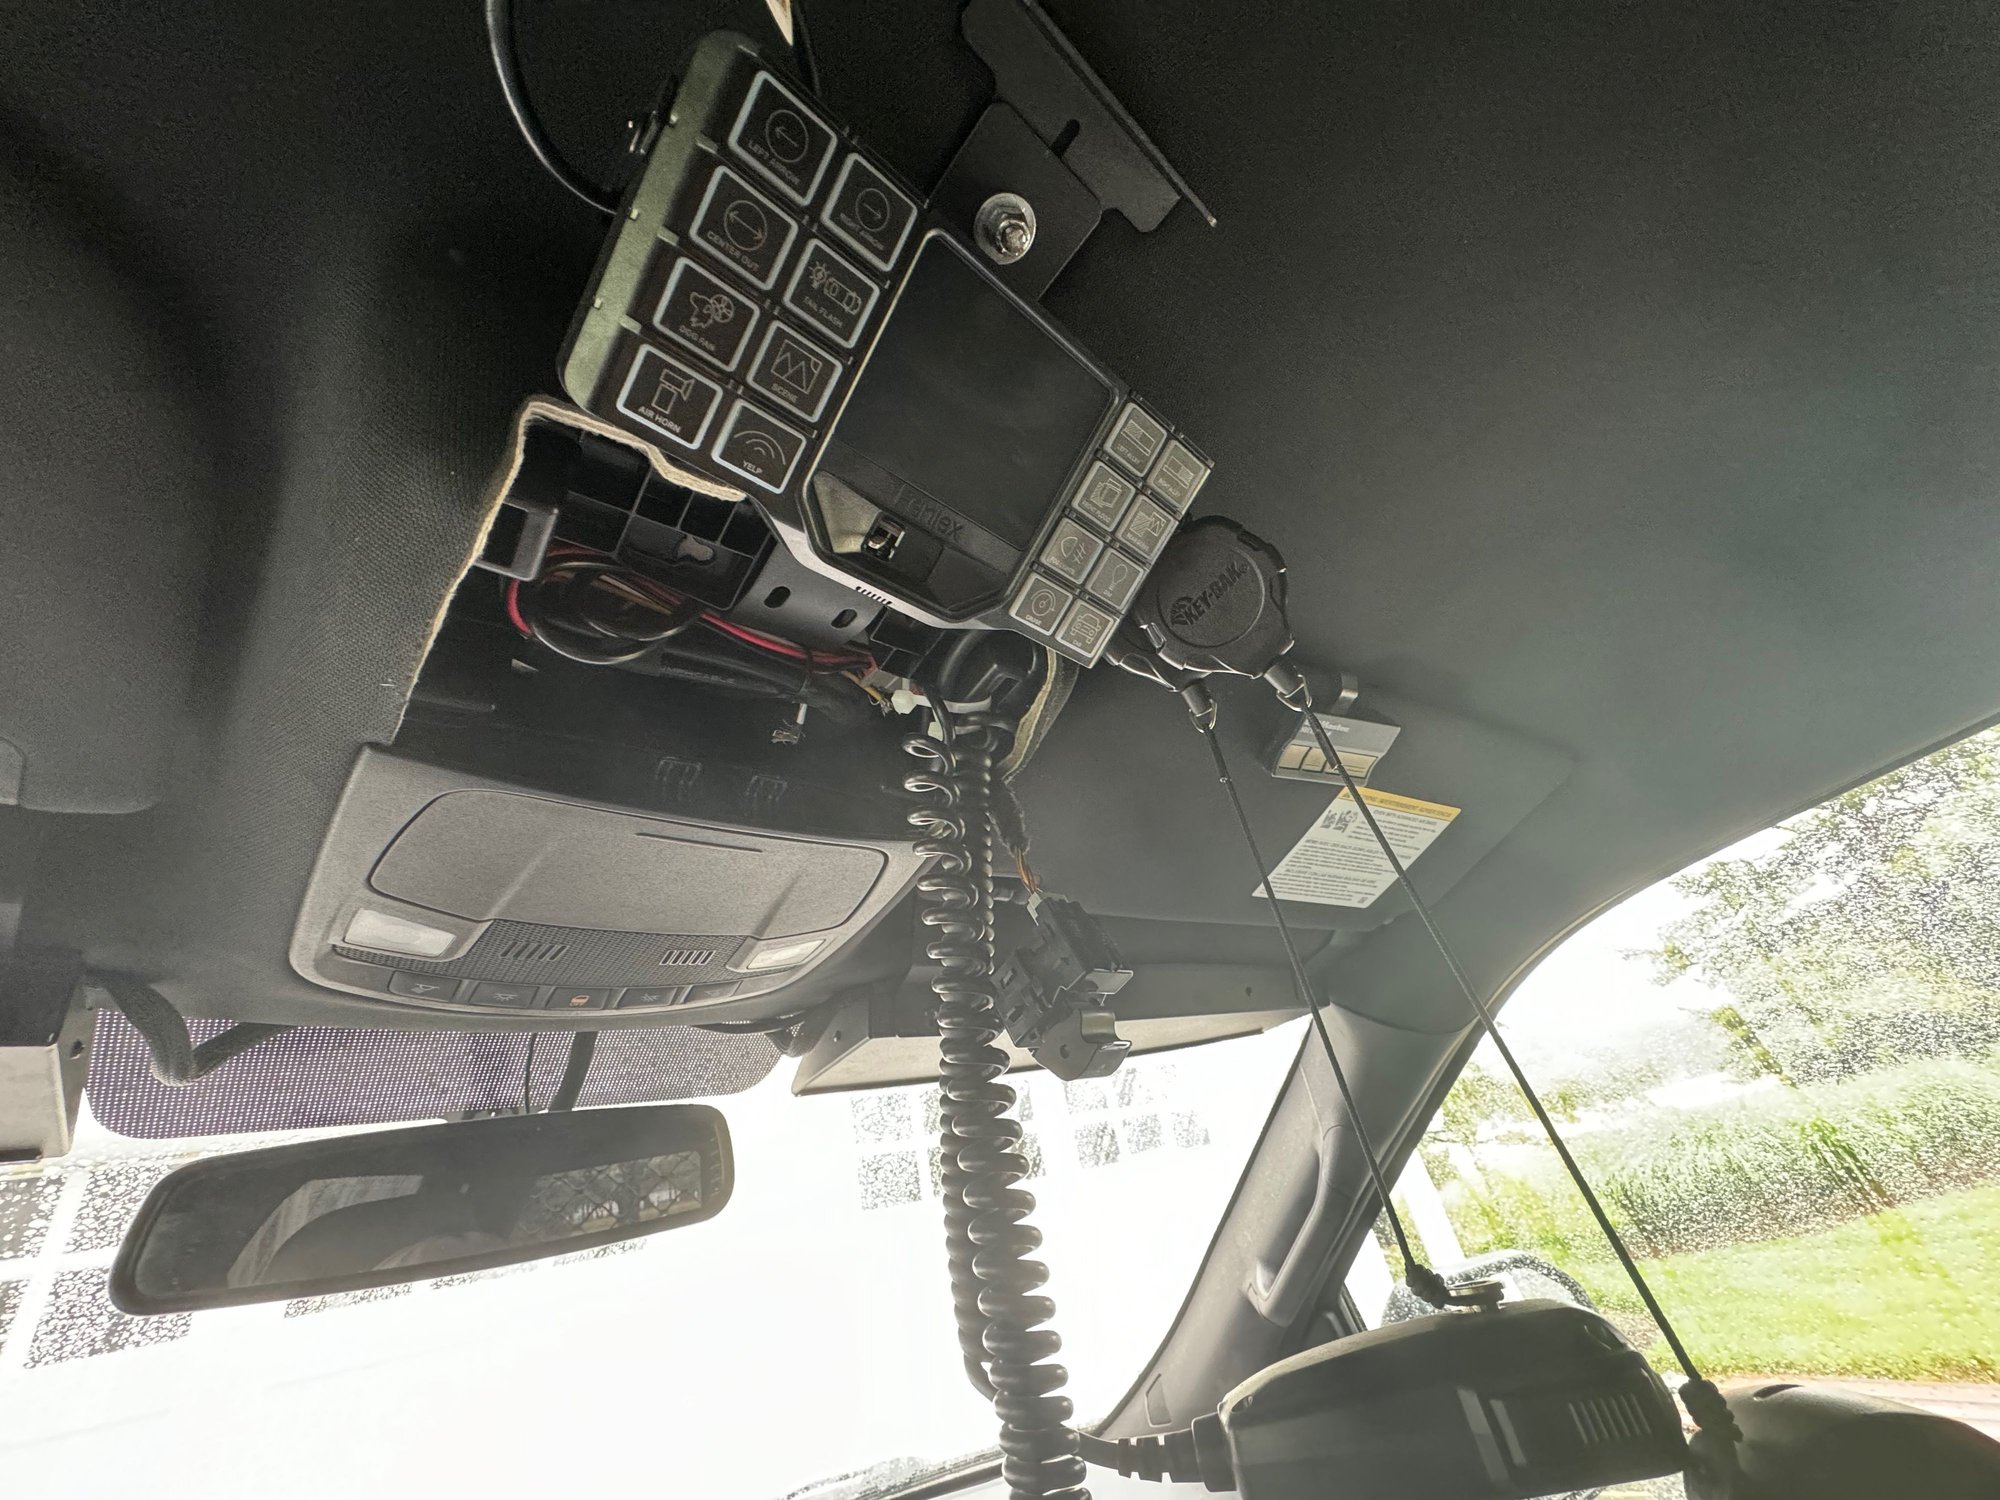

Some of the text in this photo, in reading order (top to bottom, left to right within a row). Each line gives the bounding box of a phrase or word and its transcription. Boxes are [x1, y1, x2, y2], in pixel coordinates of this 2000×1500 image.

[749, 141, 800, 184] LEFT ARROW
[840, 213, 861, 231] RIGHT
[708, 230, 759, 271] CENTER OUT
[804, 296, 843, 326] TAIL FLASH
[680, 325, 716, 349] DOG FAN
[771, 383, 798, 403] SCENE
[638, 405, 681, 433] AIR HORN
[742, 459, 764, 475] YELP
